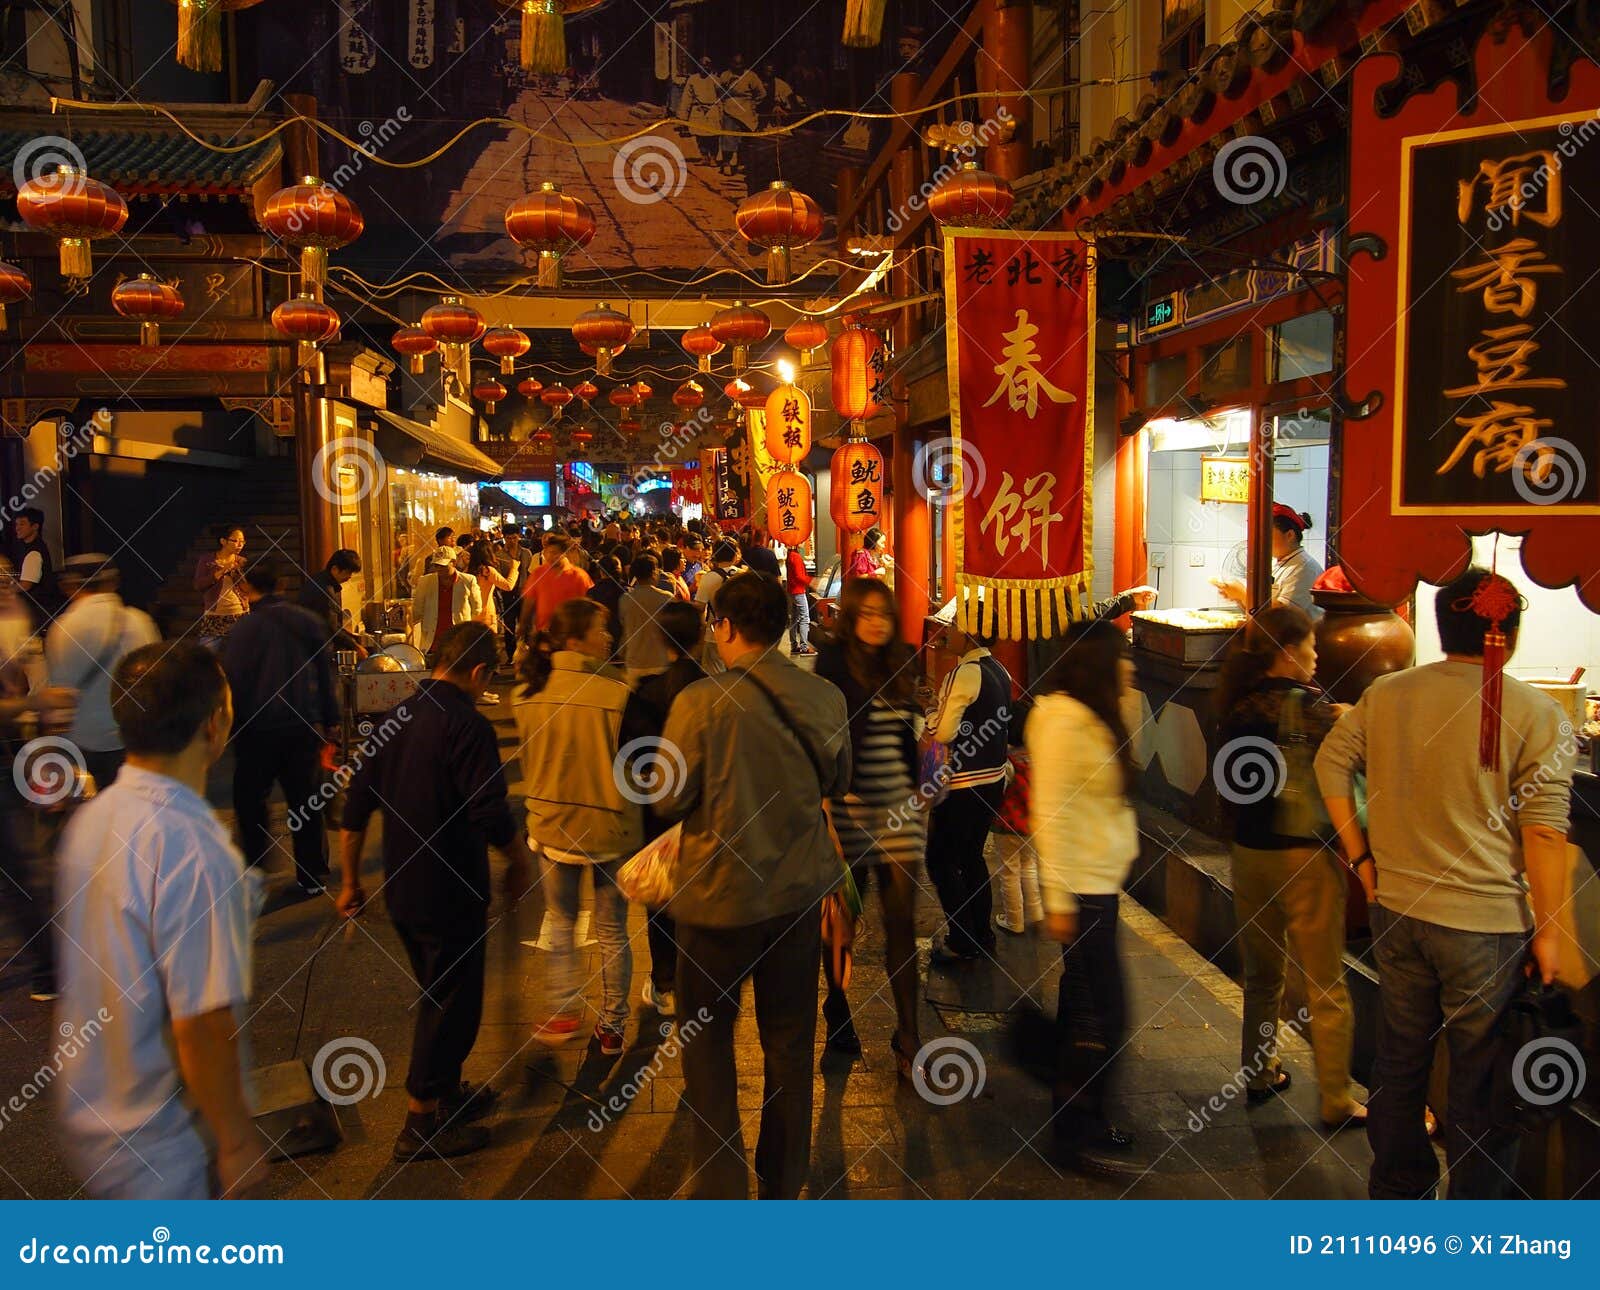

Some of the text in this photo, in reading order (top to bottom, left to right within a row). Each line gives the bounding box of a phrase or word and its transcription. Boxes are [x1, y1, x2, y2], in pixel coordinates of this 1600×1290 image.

[963, 247, 1083, 291] 老北京
[782, 399, 804, 449] 铁板
[776, 487, 800, 532] 鱿鱼
[850, 459, 880, 516] 鱿鱼
